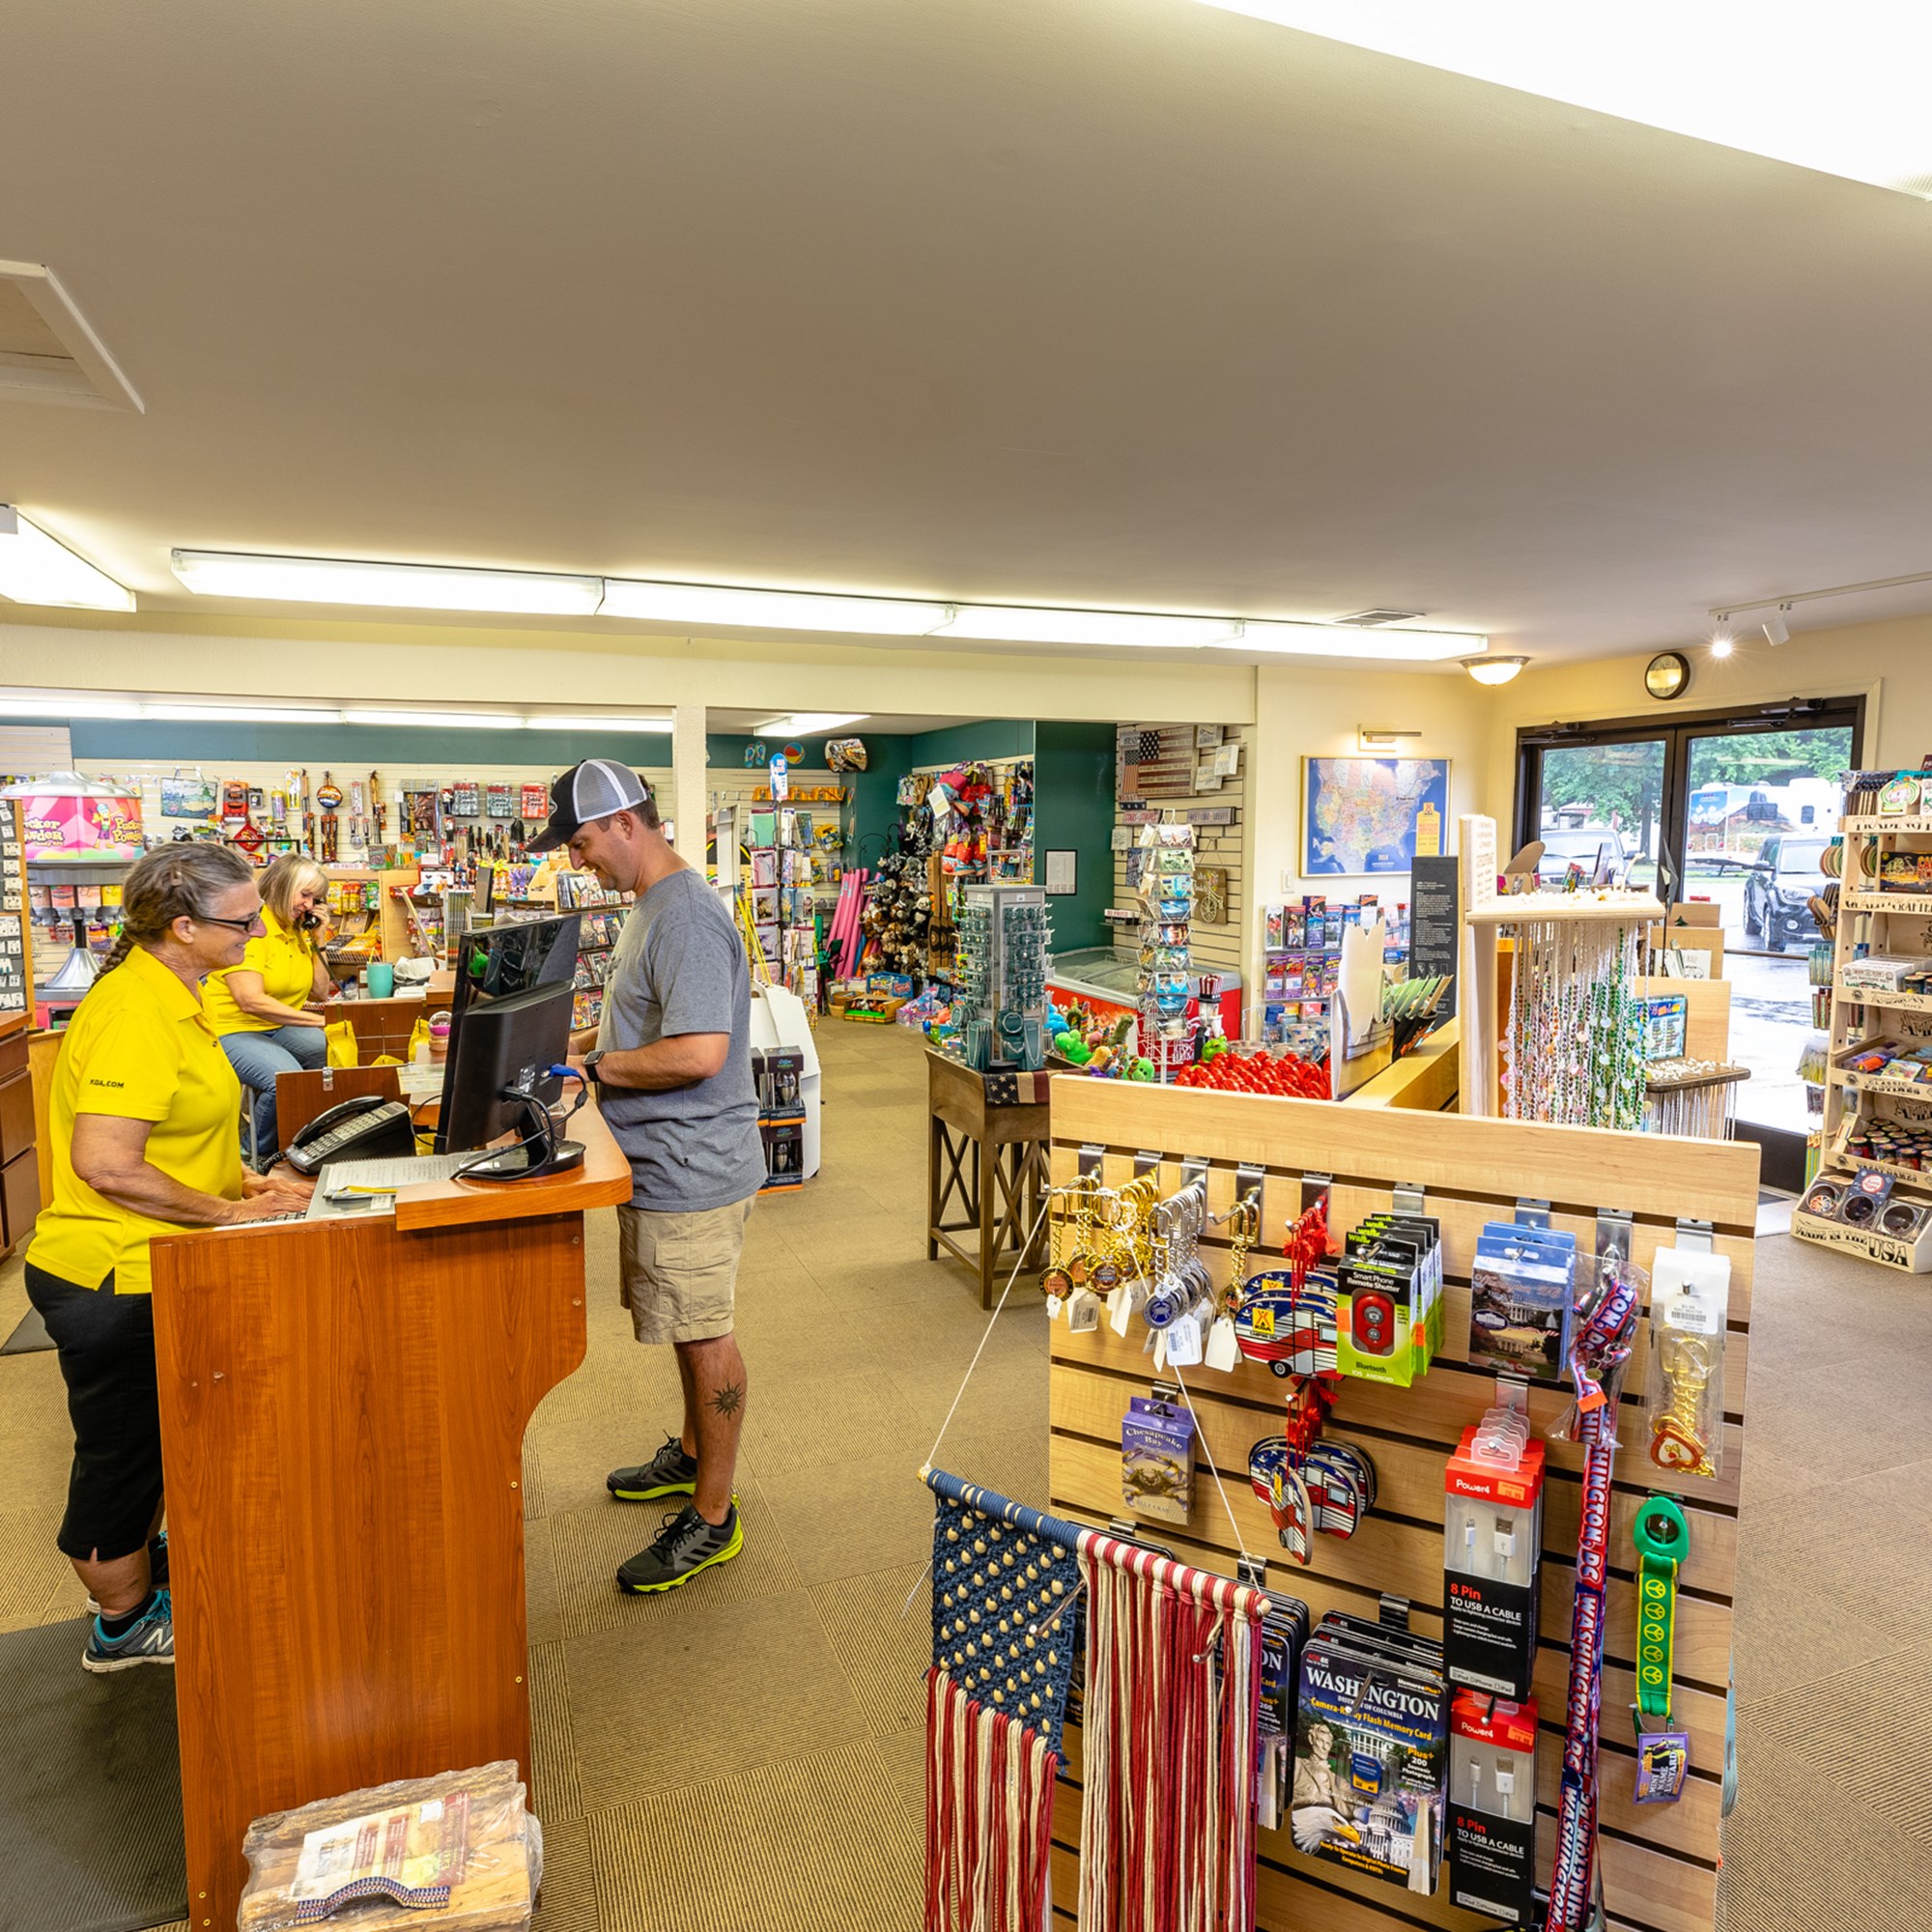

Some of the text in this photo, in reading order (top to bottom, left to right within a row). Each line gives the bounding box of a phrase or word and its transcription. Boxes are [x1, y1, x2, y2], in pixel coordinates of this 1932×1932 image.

[1796, 1225, 1910, 1267] MADE IN THE USA
[1347, 1276, 1401, 1293] Remote Shutter
[1352, 1271, 1395, 1286] Smart Phone
[1125, 1428, 1182, 1450] Chesapeake
[1145, 1435, 1163, 1448] Bay
[1456, 1478, 1491, 1494] Power4
[1580, 1549, 1602, 1584] DC
[1450, 1583, 1482, 1601] 8 Pin
[1450, 1596, 1522, 1622] TO USB A CABLE
[1305, 1665, 1440, 1721] WASHNGTON
[1310, 1696, 1433, 1742] Camera-Ry Flash Memory Card
[1372, 1705, 1404, 1720] COLUMBIA
[1461, 1721, 1494, 1739] Power4
[1406, 1747, 1435, 1761] Plus+
[1410, 1756, 1429, 1768] 200
[1657, 1766, 1669, 1791] NAME
[1663, 1751, 1678, 1793] LANYARD
[1649, 1775, 1660, 1793] MINI
[1457, 1816, 1487, 1834] 8 Pin
[1457, 1829, 1525, 1856] TO USB A CABLE
